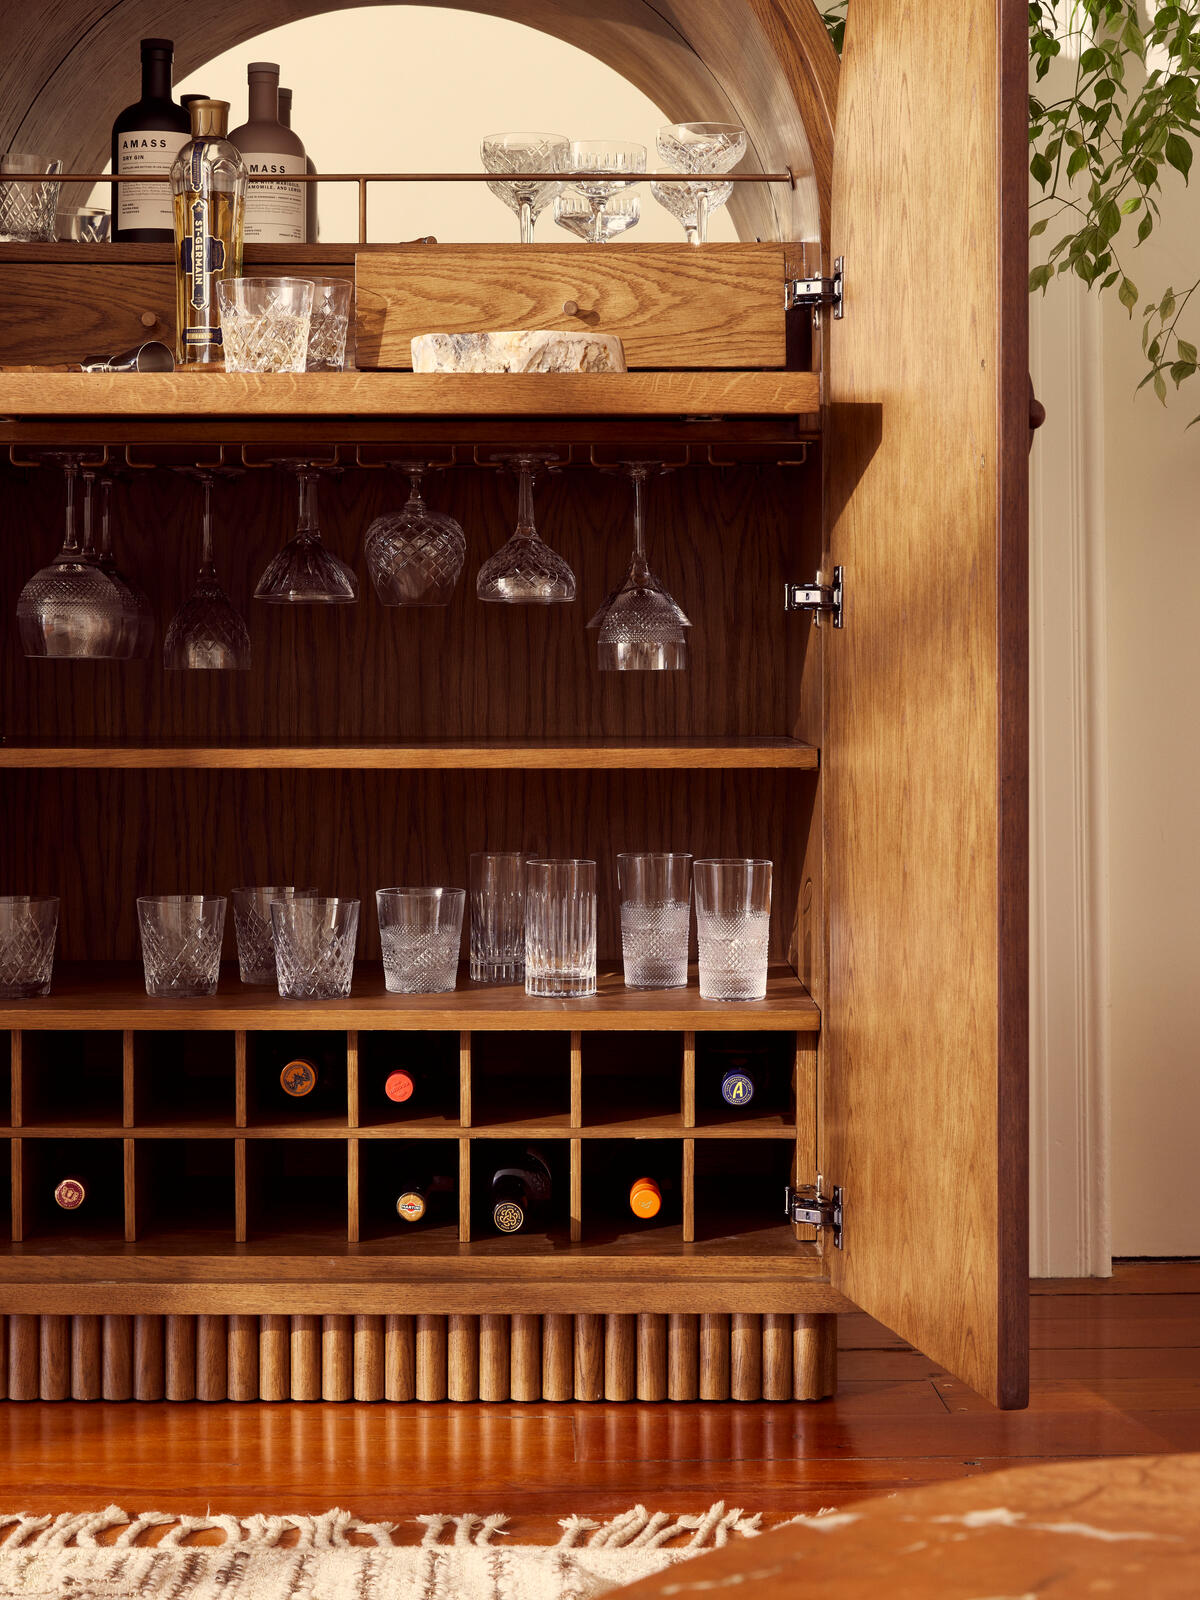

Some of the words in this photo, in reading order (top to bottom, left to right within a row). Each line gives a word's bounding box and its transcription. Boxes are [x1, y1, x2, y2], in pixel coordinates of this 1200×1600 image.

[122, 139, 167, 149] AMASS
[249, 164, 286, 174] MASS
[194, 220, 203, 285] ST-GERMAIN
[732, 1081, 743, 1099] A
